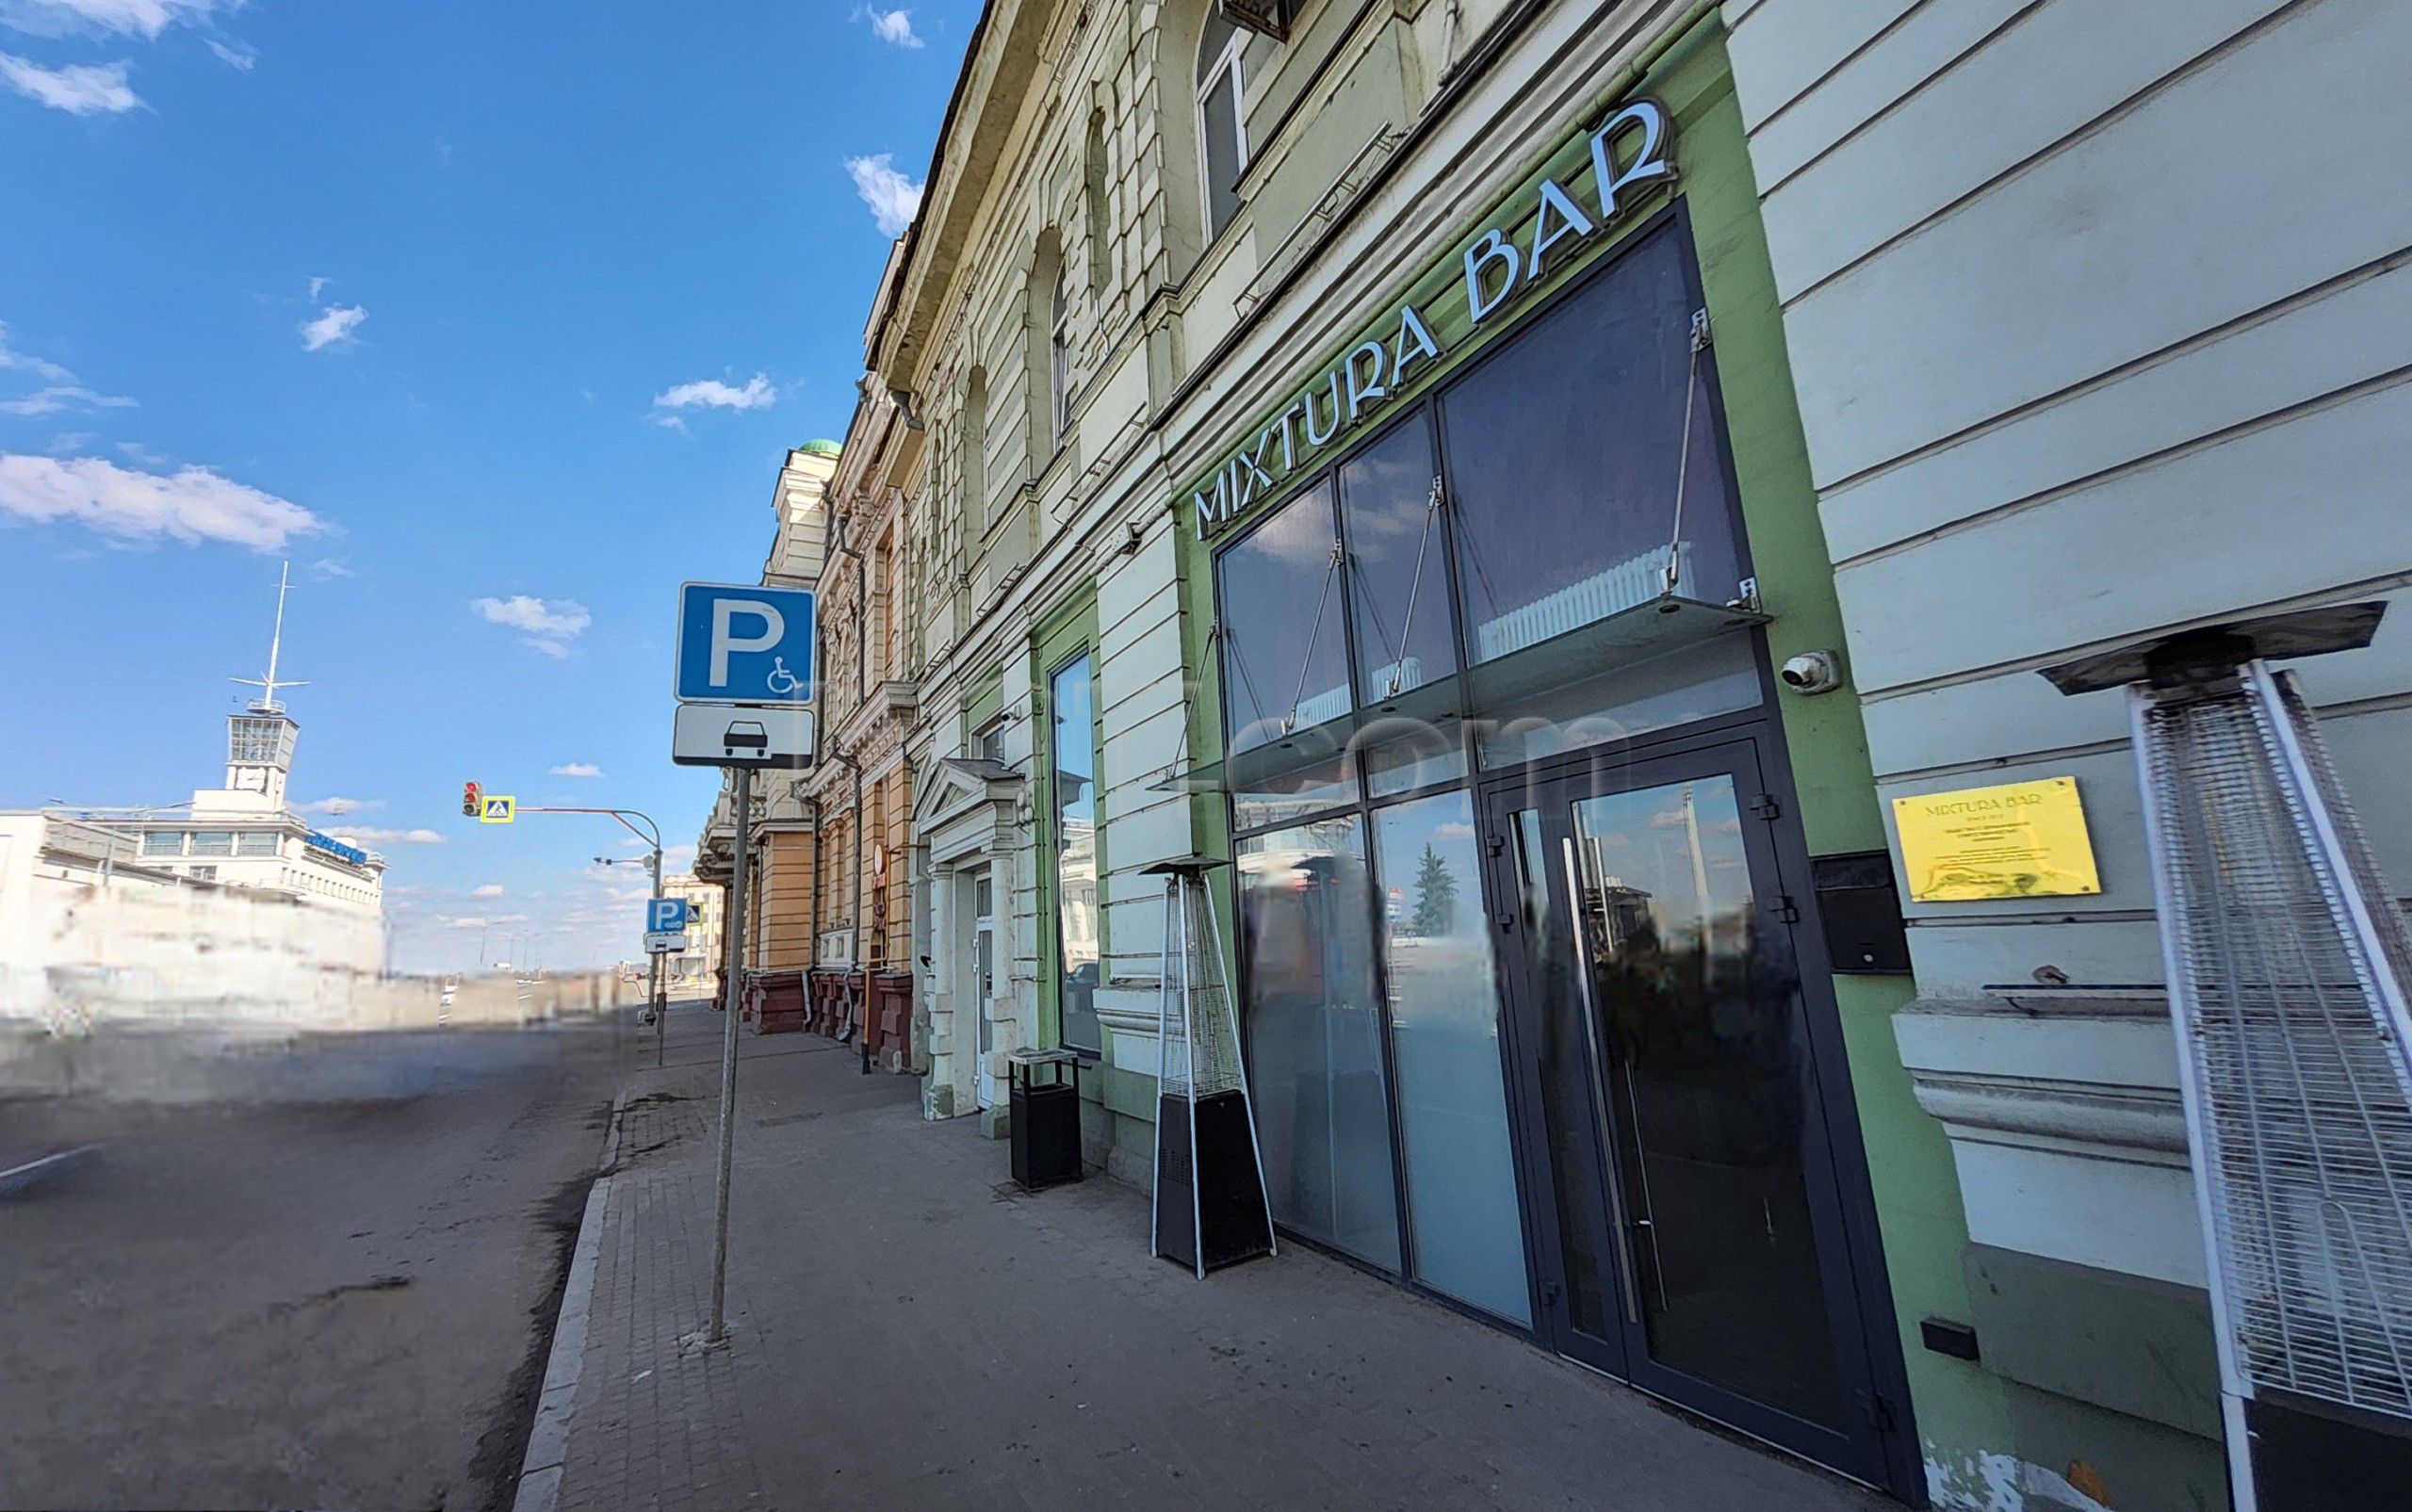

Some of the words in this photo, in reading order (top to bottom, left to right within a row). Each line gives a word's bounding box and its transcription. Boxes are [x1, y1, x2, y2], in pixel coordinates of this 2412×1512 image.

[1193, 303, 1444, 542] MIXTURA
[1462, 96, 1677, 325] BAR
[709, 598, 785, 687] P
[1925, 797, 2002, 817] MIXTURA
[655, 902, 678, 930] P
